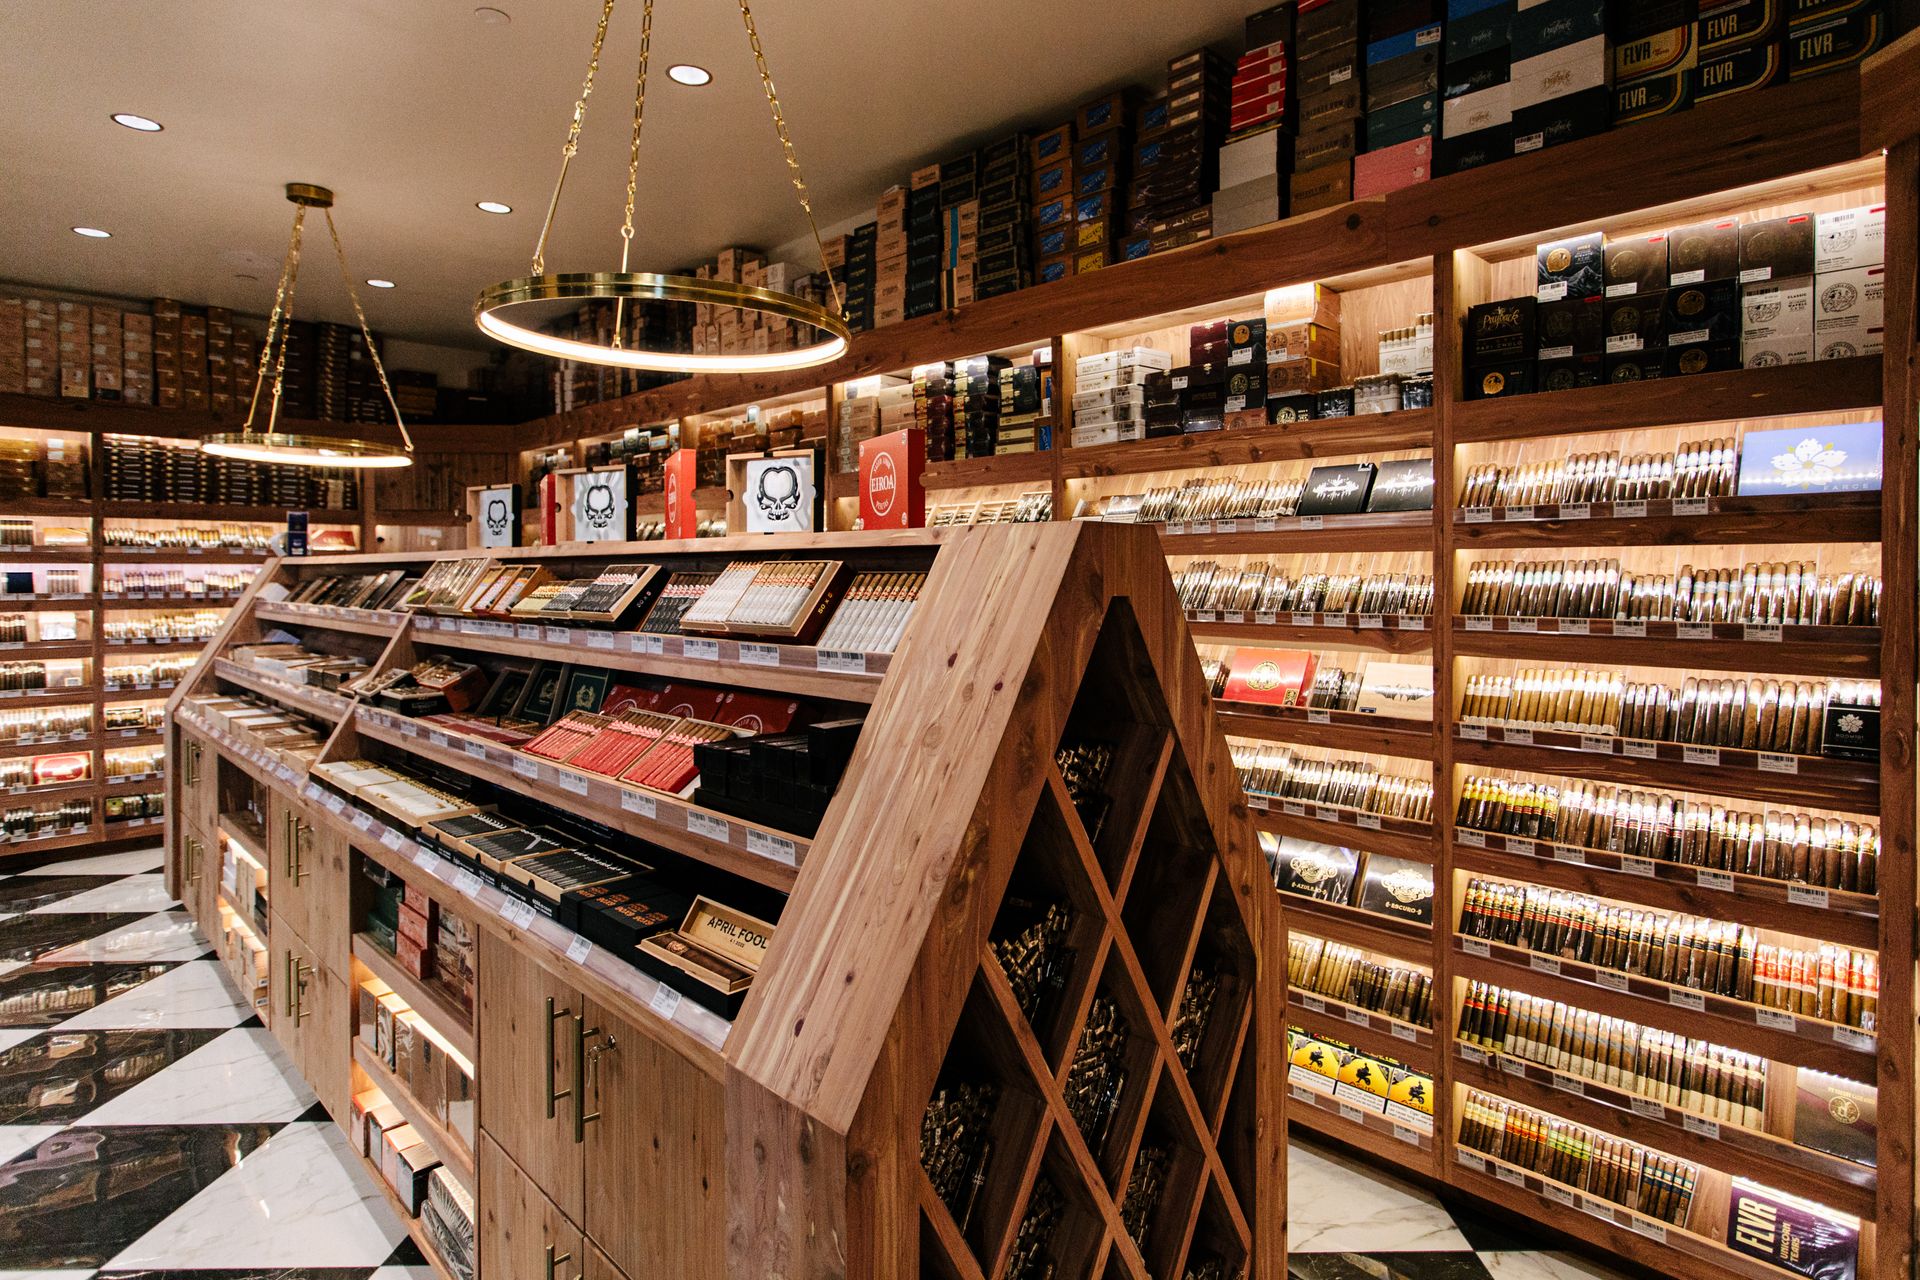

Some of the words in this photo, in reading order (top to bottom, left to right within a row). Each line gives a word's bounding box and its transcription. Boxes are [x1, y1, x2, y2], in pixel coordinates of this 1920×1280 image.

[1707, 14, 1738, 40] FLVR
[1623, 41, 1651, 66] FLVR
[1800, 32, 1833, 60] FLVR
[1703, 61, 1734, 87] FLVR
[1618, 87, 1647, 112] FLVR
[1080, 226, 1103, 244] ACID
[1080, 256, 1103, 274] ACID
[1787, 292, 1807, 300] CLASSIC
[1482, 307, 1520, 330] Payback
[871, 475, 895, 492] EIROA
[817, 603, 826, 615] 50
[707, 917, 736, 937] APRIL
[737, 928, 767, 949] FOOL
[1348, 1081, 1376, 1093] ACID
[1400, 1098, 1430, 1112] ACID
[1736, 1197, 1777, 1254] FLVR
[1780, 1221, 1792, 1260] UNICORN
[1790, 1236, 1801, 1262] TEARS
